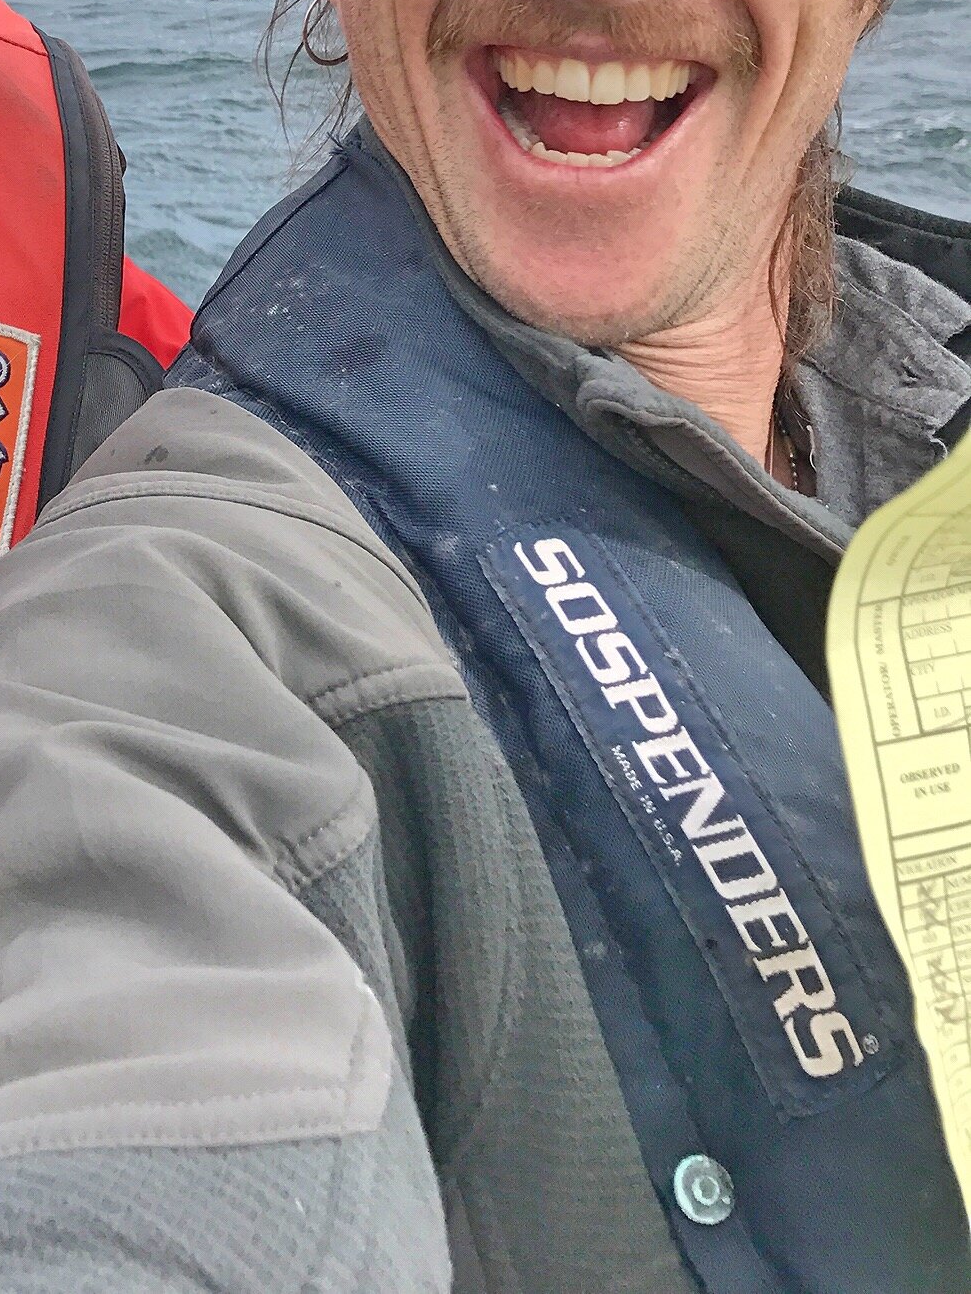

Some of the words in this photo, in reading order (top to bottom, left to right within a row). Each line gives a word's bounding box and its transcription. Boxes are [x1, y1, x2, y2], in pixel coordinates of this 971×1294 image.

[514, 537, 865, 1078] SOSPENDERS
[610, 744, 643, 792] MADE
[639, 794, 658, 815] IN
[899, 762, 961, 784] OBSERVED
